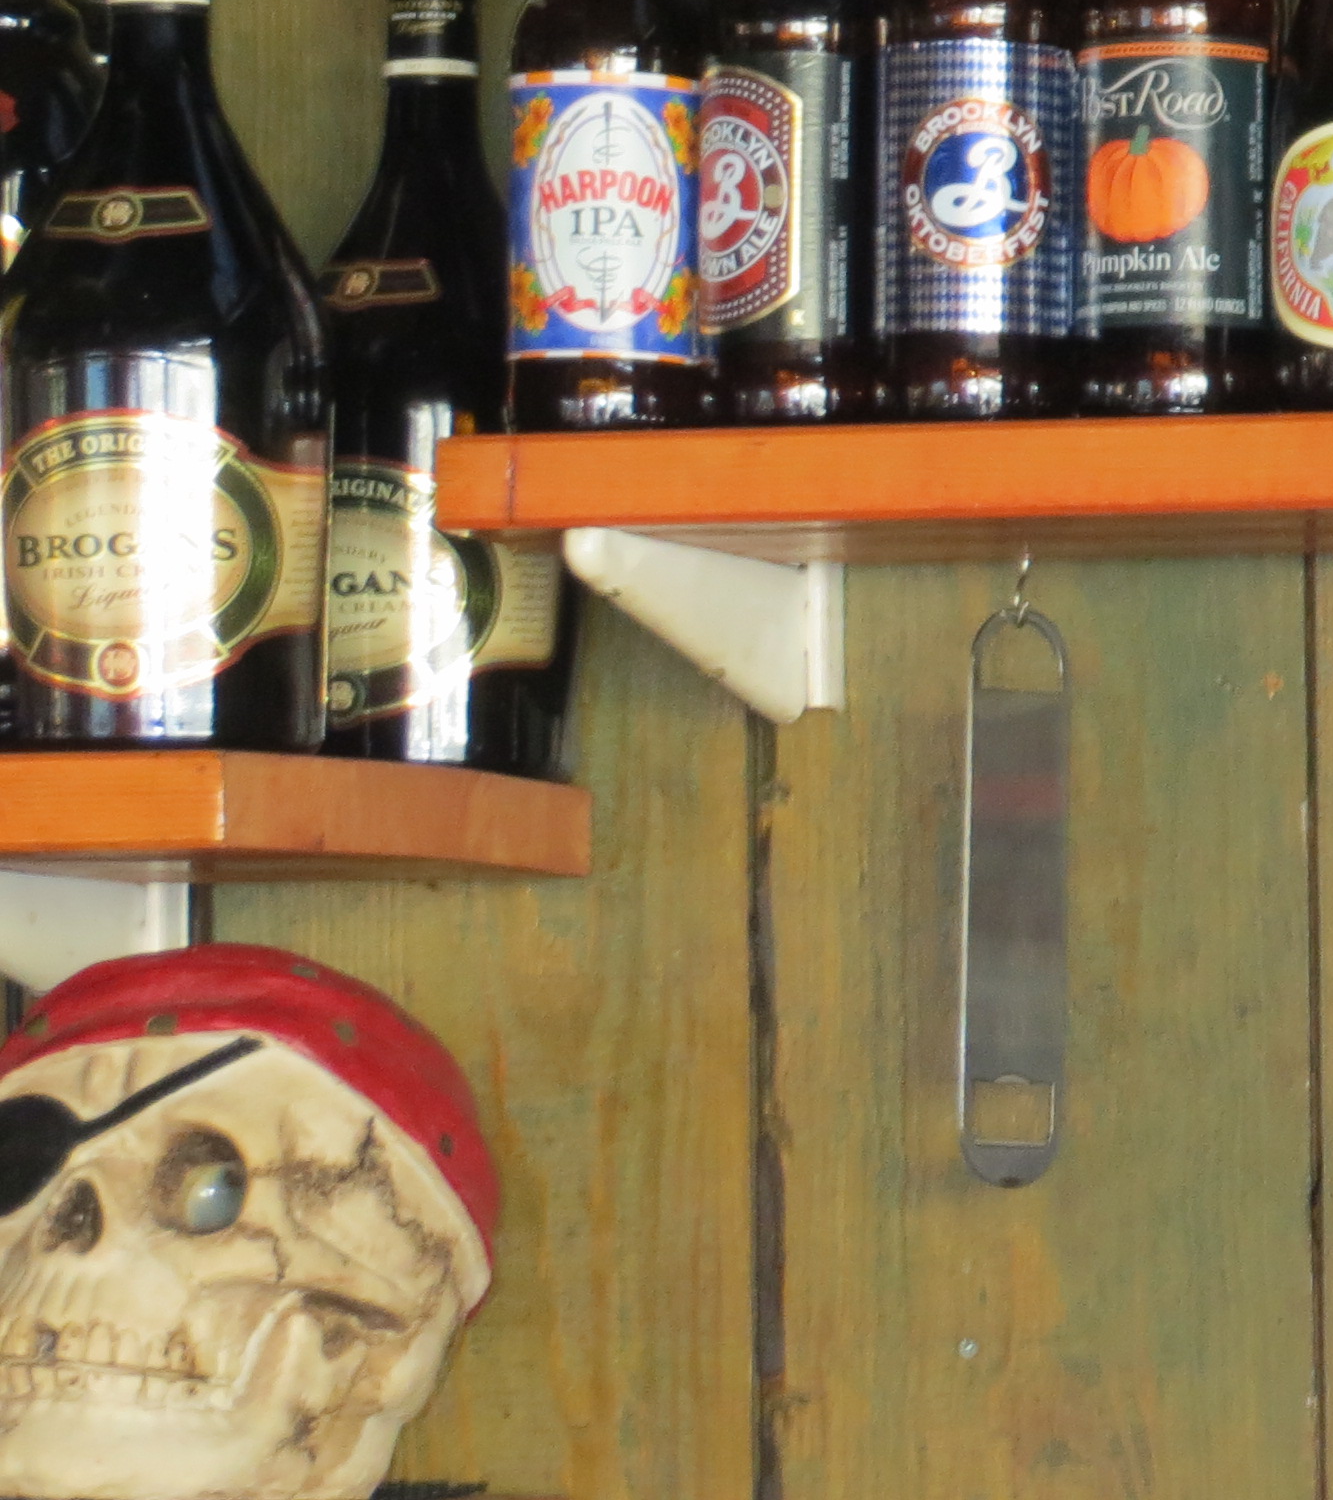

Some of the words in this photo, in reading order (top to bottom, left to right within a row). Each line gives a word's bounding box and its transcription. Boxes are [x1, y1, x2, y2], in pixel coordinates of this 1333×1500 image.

[914, 101, 1042, 154] BROOKLYN
[702, 123, 774, 171] OKLYN
[538, 169, 676, 217] HARPOON
[570, 205, 644, 239] IPA
[904, 183, 1050, 263] OKTOBERFEST
[702, 257, 738, 277] OWN
[742, 210, 779, 269] ALE
[1082, 245, 1172, 279] Pumpkin
[1176, 245, 1221, 273] Ale
[31, 442, 76, 474] THE
[331, 477, 412, 503] RIGINA
[64, 502, 146, 527] LEGEND
[16, 529, 239, 568] BROGS
[42, 566, 105, 581] IRISH
